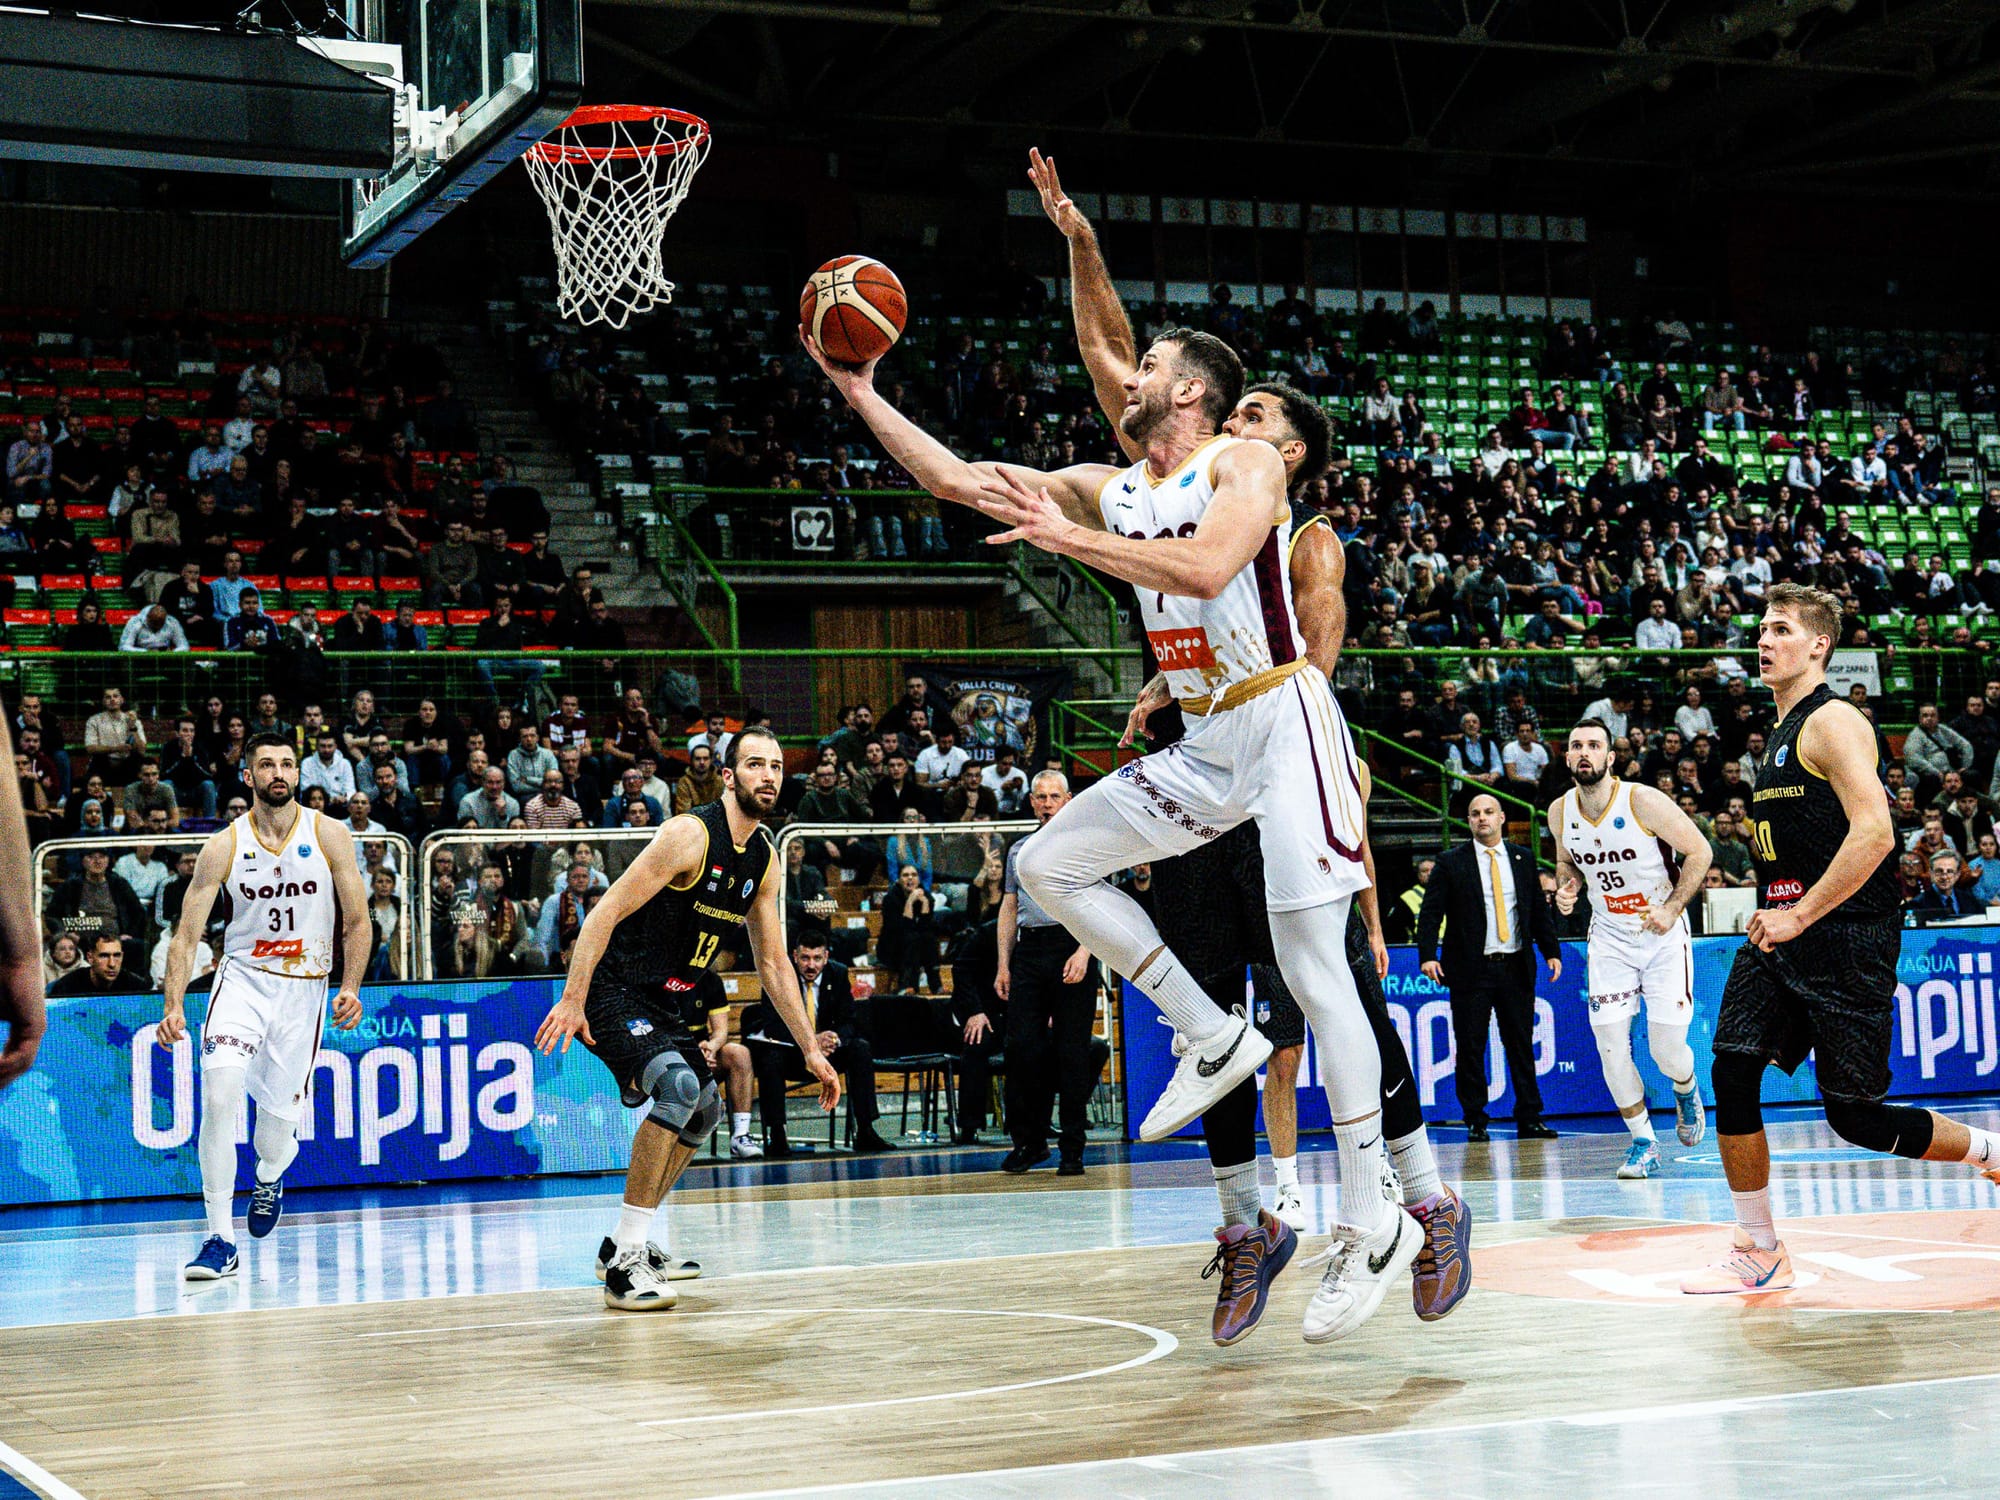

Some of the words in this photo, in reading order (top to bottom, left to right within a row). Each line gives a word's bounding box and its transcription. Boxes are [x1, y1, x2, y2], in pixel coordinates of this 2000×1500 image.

[795, 510, 834, 546] C2
[1154, 641, 1178, 661] bh
[958, 680, 987, 690] YALLA
[989, 681, 1017, 693] CREW
[1570, 848, 1637, 865] bosna
[239, 880, 318, 901] bosna
[1596, 871, 1626, 892] 35
[268, 906, 295, 932] 31
[689, 931, 720, 969] 13
[131, 1013, 535, 1166] Ompija
